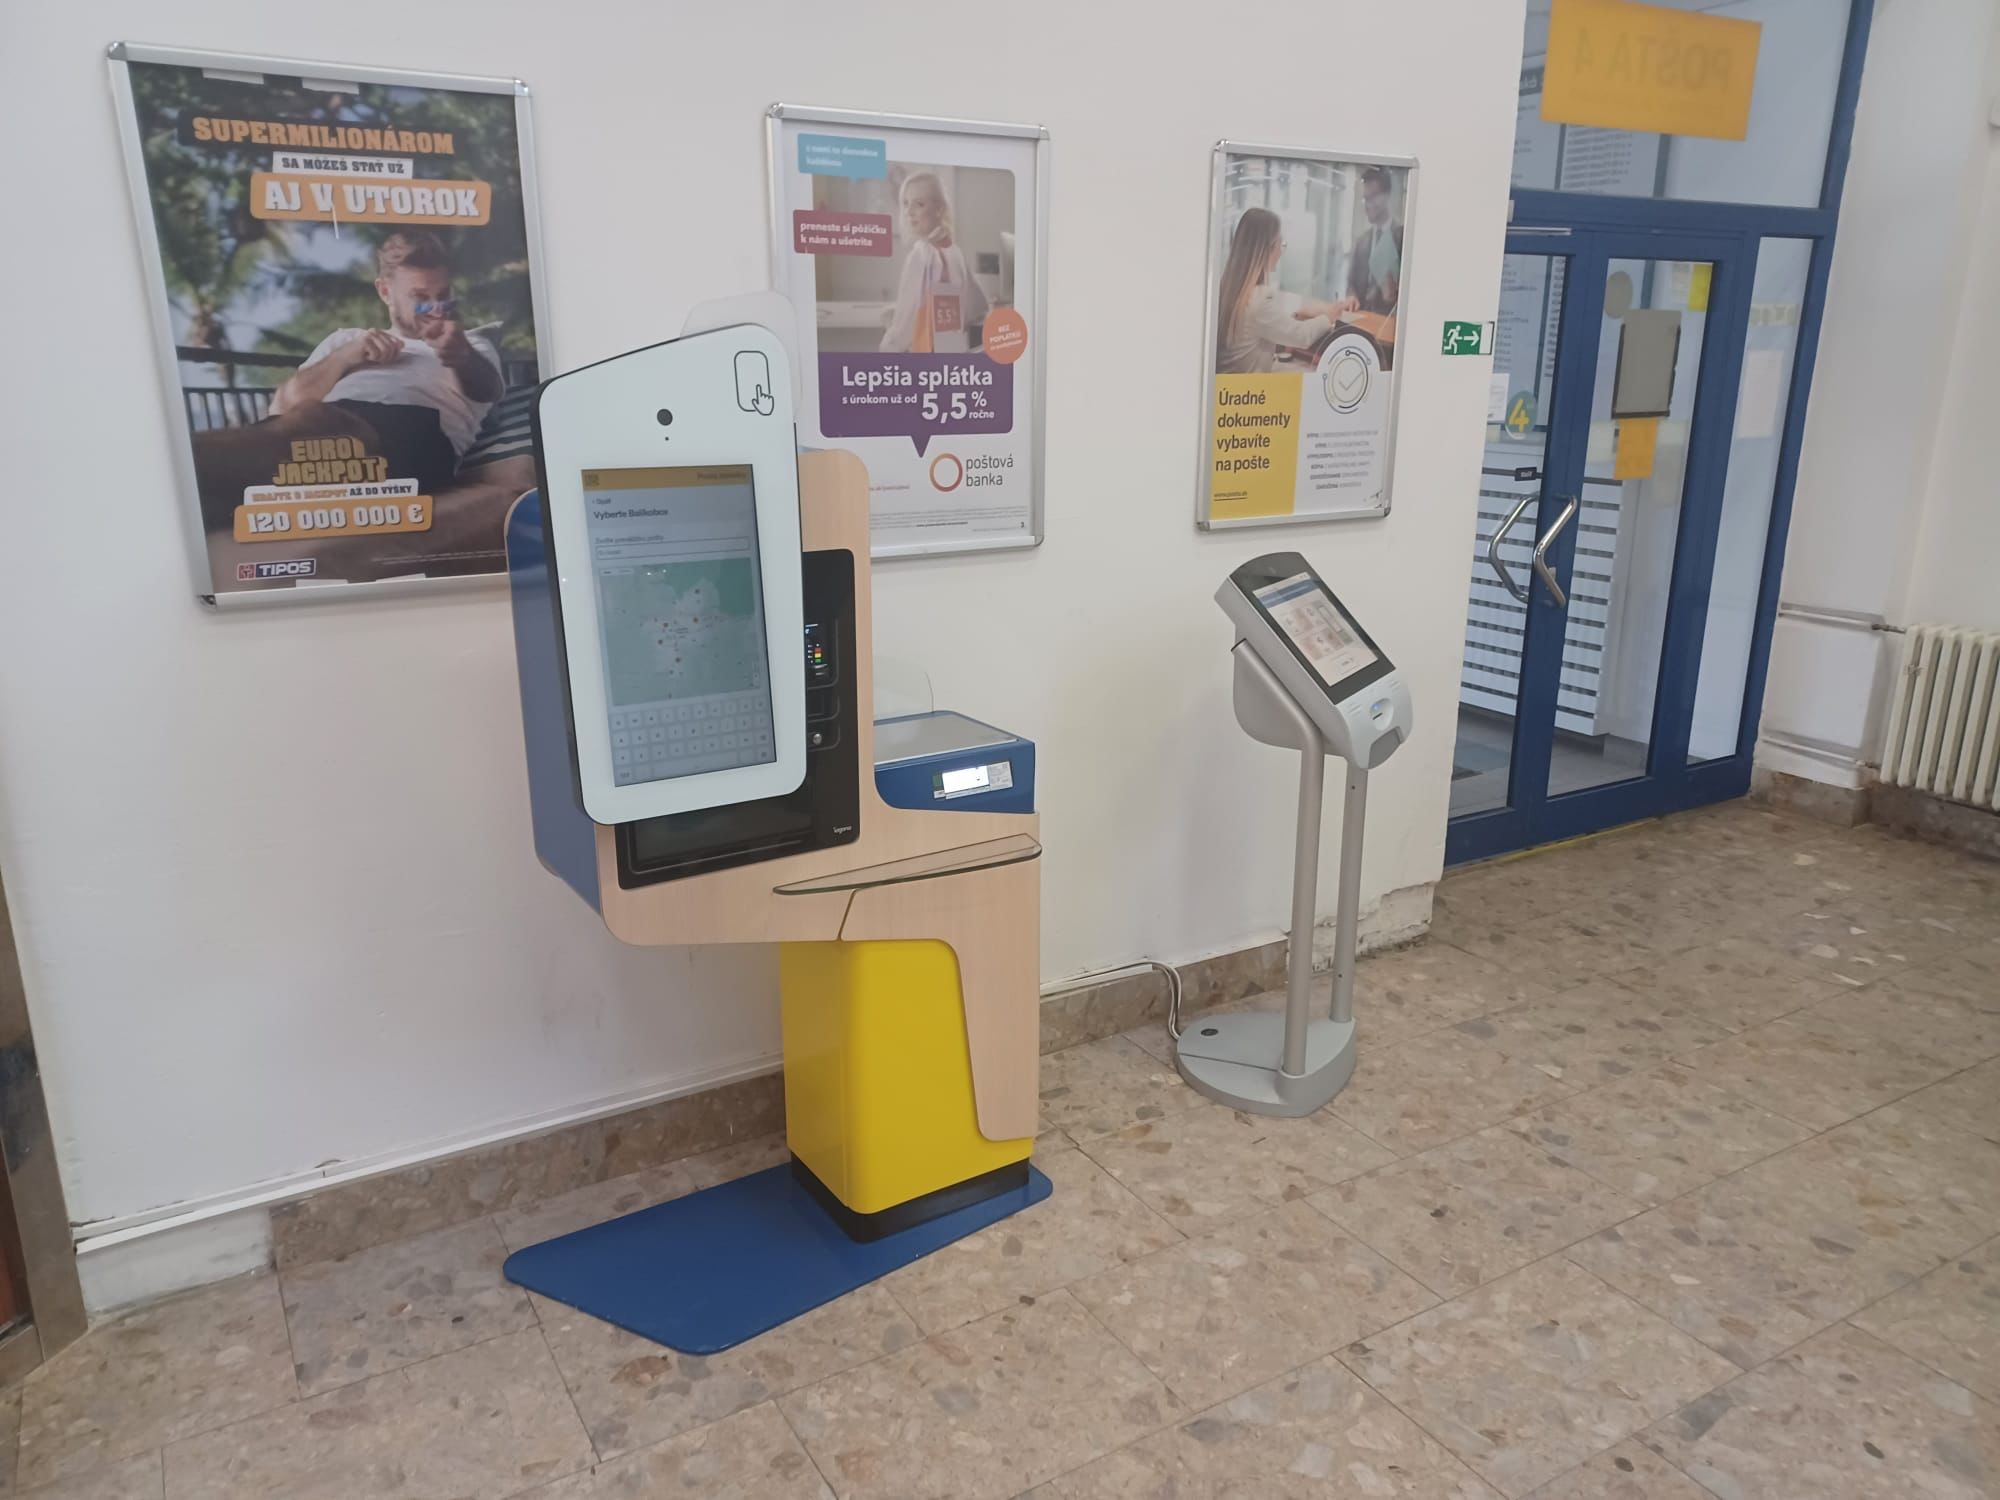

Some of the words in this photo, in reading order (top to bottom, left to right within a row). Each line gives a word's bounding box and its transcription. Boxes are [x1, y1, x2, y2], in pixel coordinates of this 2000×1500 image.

[192, 116, 455, 155] SUPERMILIONÁROM
[281, 157, 299, 169] SA
[388, 161, 405, 174] UŽ
[265, 180, 301, 211] AJ
[309, 183, 333, 212] V
[342, 184, 480, 217] UTOROK
[800, 222, 841, 235] preneste
[842, 223, 851, 233] si
[801, 234, 807, 244] k
[808, 235, 829, 245] nám
[830, 237, 837, 245] a
[838, 235, 873, 247] ušetrite
[842, 365, 913, 392] Lepšia
[918, 365, 993, 391] splátka
[1218, 388, 1266, 406] Úradné
[842, 396, 848, 405] s
[849, 395, 889, 405] úrokom
[890, 394, 903, 404] už
[904, 393, 918, 404] od
[921, 392, 967, 424] 5,5
[969, 409, 995, 419] ročne
[1508, 398, 1529, 432] 4
[1217, 412, 1291, 428] dokumenty
[291, 437, 358, 462] EURO
[1216, 434, 1271, 452] vybavíte
[272, 458, 382, 485] JACKPOT
[965, 454, 1014, 471] poštová
[1215, 459, 1231, 471] na
[1233, 456, 1270, 474] pošte
[965, 473, 1003, 487] banka
[366, 487, 378, 495] DO
[247, 511, 290, 533] 120
[297, 508, 346, 530] 000
[354, 505, 400, 526] 000
[407, 503, 424, 523] €
[593, 509, 627, 520] Vyberte
[259, 562, 312, 577] TIPOS
